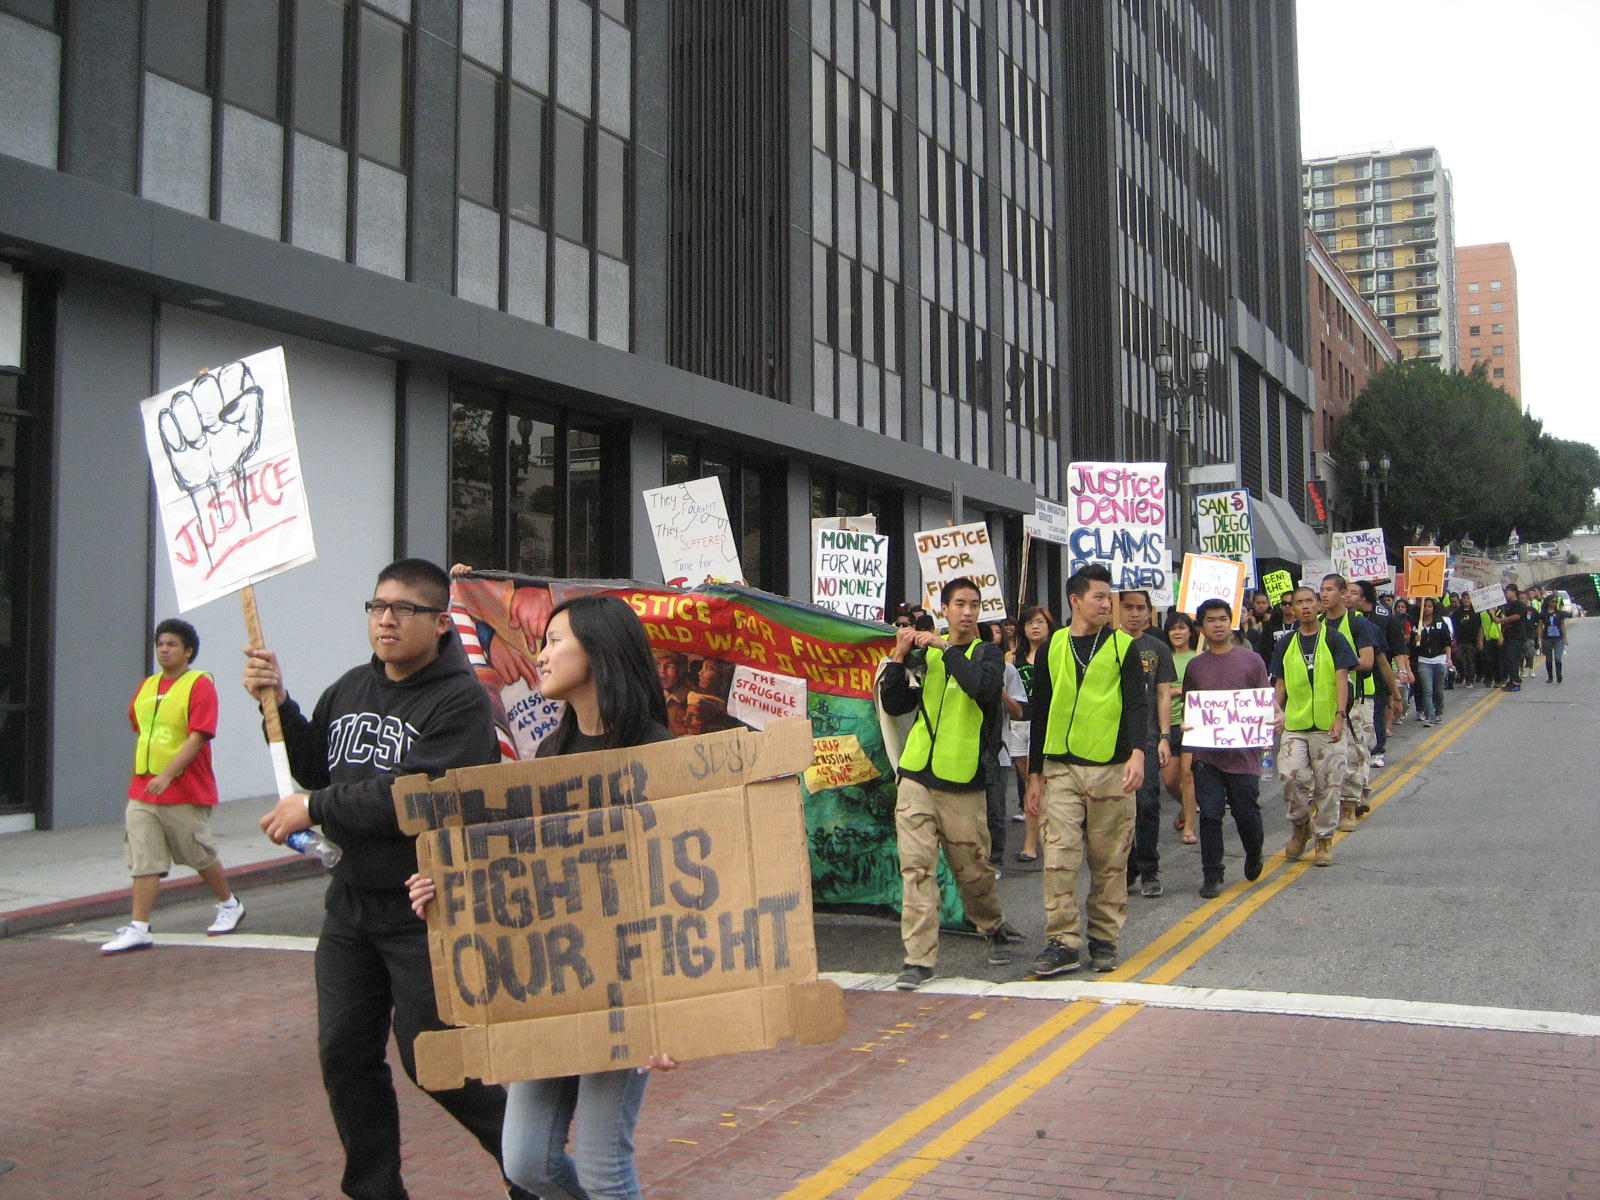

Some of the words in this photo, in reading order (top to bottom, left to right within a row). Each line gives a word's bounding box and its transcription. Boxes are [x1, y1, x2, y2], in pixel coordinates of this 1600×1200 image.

[175, 457, 297, 567] JUSTICE
[650, 493, 677, 511] They
[1198, 496, 1229, 516] SAN
[655, 524, 678, 539] They
[1213, 513, 1250, 534] DIEGO
[821, 531, 886, 554] MONEY
[917, 528, 988, 553] JUSTICE
[1069, 527, 1164, 565] CLAIMS
[1201, 534, 1251, 553] STUDENTS
[821, 554, 849, 574] FOR
[852, 556, 884, 578] WAR
[936, 552, 974, 574] FOR
[1366, 556, 1379, 565] MY
[926, 574, 997, 597] FINO
[1069, 558, 1166, 591] DLAYED
[817, 577, 837, 596] NO
[839, 579, 885, 598] MONEY
[1192, 580, 1210, 592] NO
[1214, 586, 1230, 597] NO
[979, 597, 1004, 612] ETS
[622, 593, 711, 624] STICE
[734, 610, 776, 645] FOR
[643, 622, 694, 643] RLD
[705, 631, 767, 664] WAR
[751, 672, 776, 686] THE
[736, 679, 796, 708] STRUGGLE
[1188, 692, 1228, 711] Money
[1233, 691, 1252, 708] For
[508, 691, 547, 721] RESCISSI
[518, 711, 537, 731] ACT
[542, 702, 559, 714] OF
[531, 717, 559, 741] 1946
[1202, 709, 1221, 726] No
[1227, 708, 1264, 737] Money
[1214, 727, 1236, 746] For
[816, 766, 833, 776] ACT
[839, 764, 853, 774] OF
[404, 761, 657, 866] THEIR
[443, 844, 628, 928] FIGHT
[648, 830, 720, 911] IS
[452, 923, 595, 1007] OUR
[616, 892, 799, 981] FIGHT
